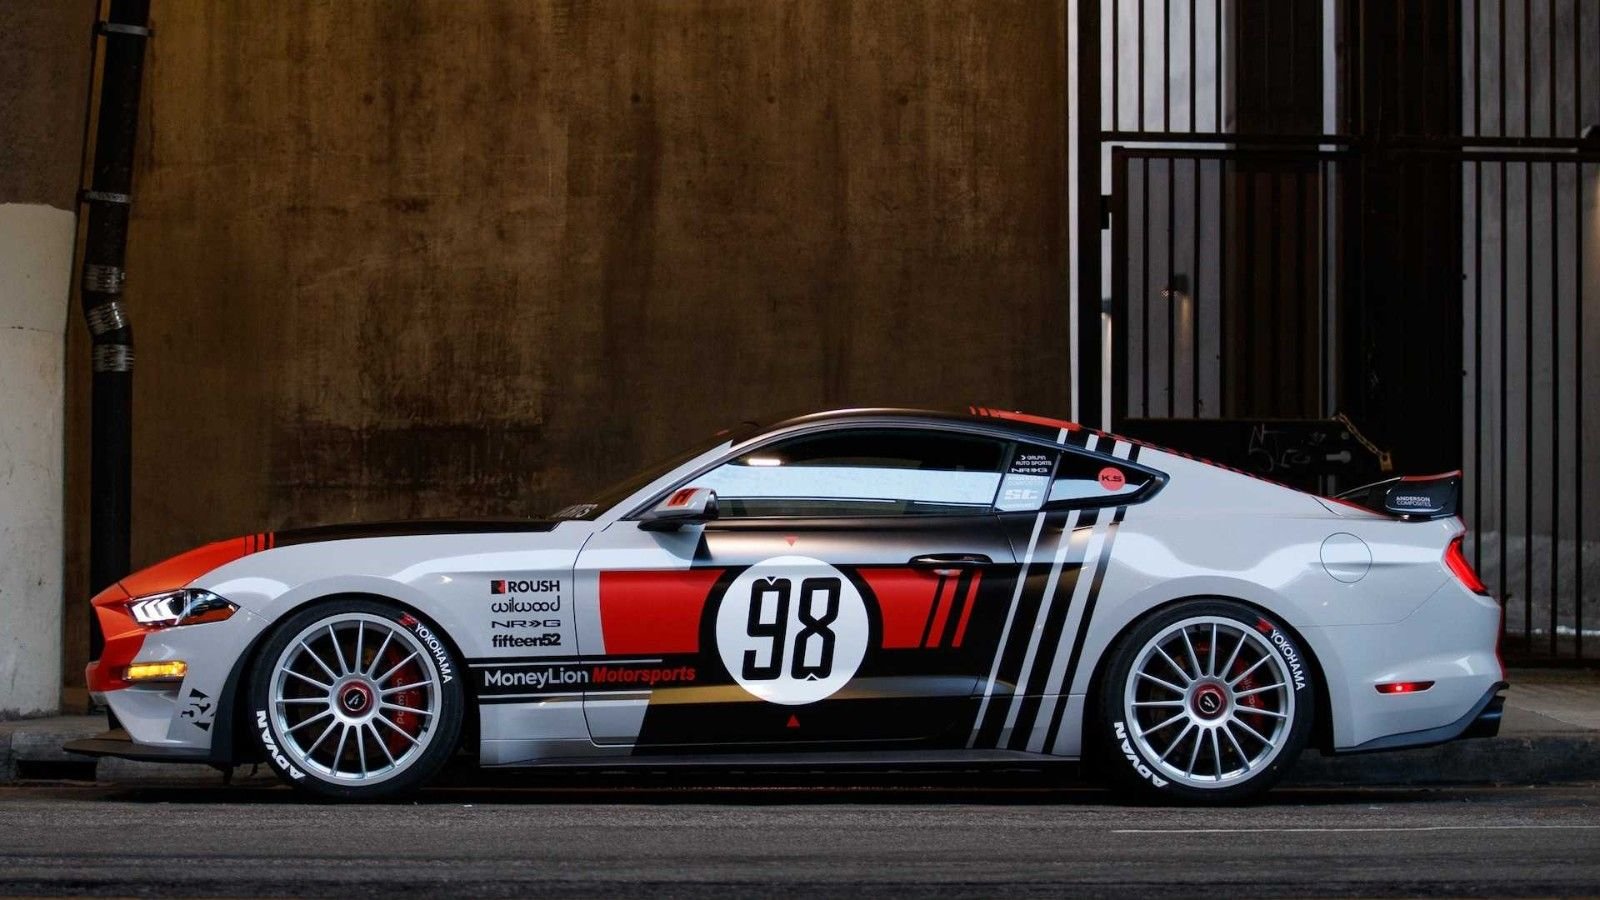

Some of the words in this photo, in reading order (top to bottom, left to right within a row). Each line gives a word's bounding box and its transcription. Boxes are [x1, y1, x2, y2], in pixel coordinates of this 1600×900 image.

[491, 596, 560, 613] wilwood
[508, 580, 560, 592] ROUSH
[415, 622, 453, 684] YOKOHAMA
[492, 633, 561, 647] fifteen52
[742, 576, 842, 681] 98
[484, 668, 589, 689] MoneyLion
[592, 666, 696, 685] Motorsports
[1270, 629, 1306, 691] YOKOHAMA
[256, 710, 306, 780] ADVAN
[1114, 721, 1169, 788] ADVAN
